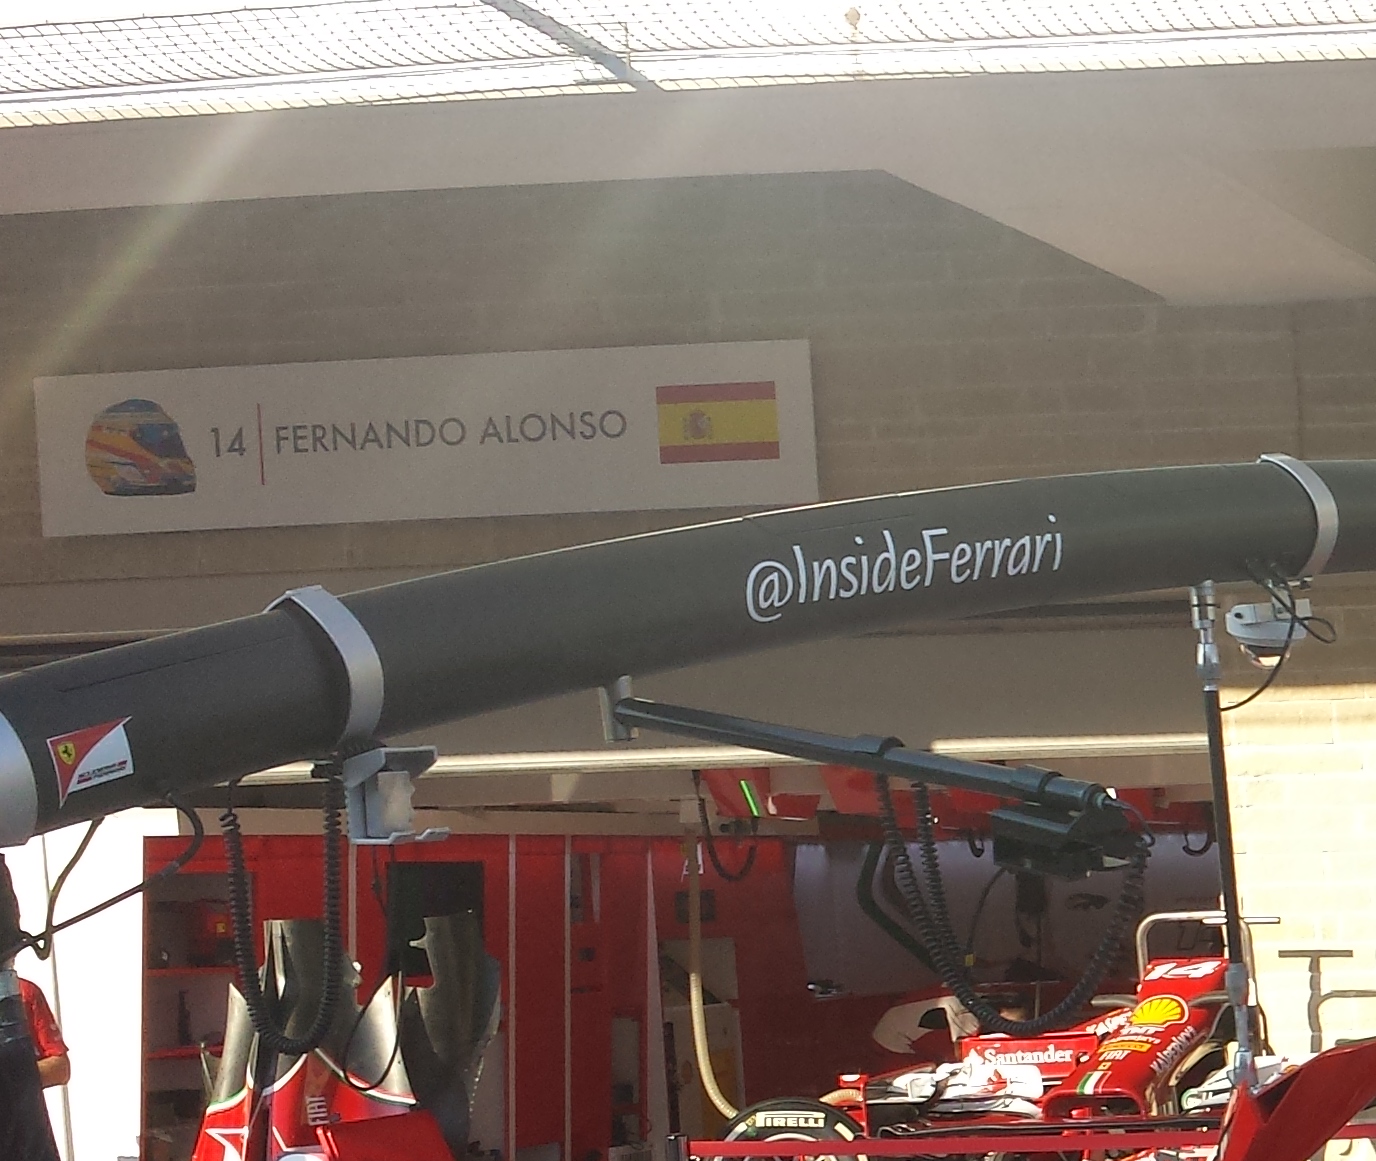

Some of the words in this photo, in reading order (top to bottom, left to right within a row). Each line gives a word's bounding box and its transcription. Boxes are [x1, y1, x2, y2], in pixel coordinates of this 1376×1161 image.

[210, 426, 247, 458] 14
[275, 416, 467, 455] FERNANDO
[479, 410, 628, 446] ALONSO
[745, 513, 1064, 623] @InsideFerrari
[1144, 960, 1222, 981] 14
[983, 1043, 1075, 1065] Santander
[305, 1095, 330, 1127] FIAT
[755, 1110, 826, 1128] PIRELLI
